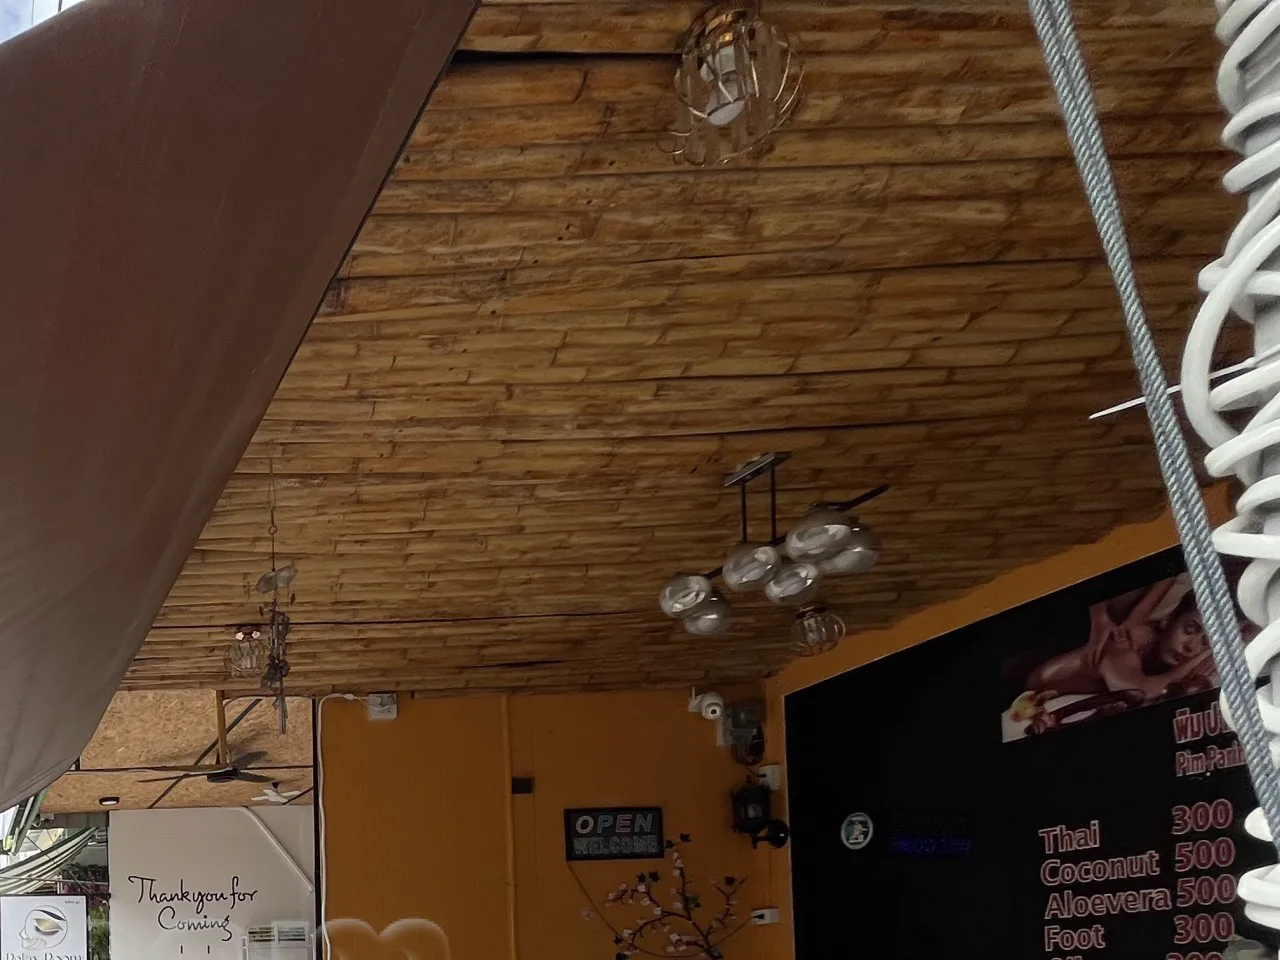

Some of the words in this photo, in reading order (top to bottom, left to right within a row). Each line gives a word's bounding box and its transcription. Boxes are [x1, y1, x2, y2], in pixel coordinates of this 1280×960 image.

[575, 814, 653, 834] OPEN
[1038, 820, 1100, 854] Thai
[1172, 799, 1233, 835] 300
[1041, 850, 1160, 886] Coconut
[1175, 837, 1236, 872] 500
[229, 876, 258, 909] for
[1044, 888, 1172, 920] Aloevera
[1177, 873, 1237, 908] 500
[157, 905, 233, 942] Coming
[1044, 924, 1106, 951] Foot
[1174, 912, 1235, 944] 300
